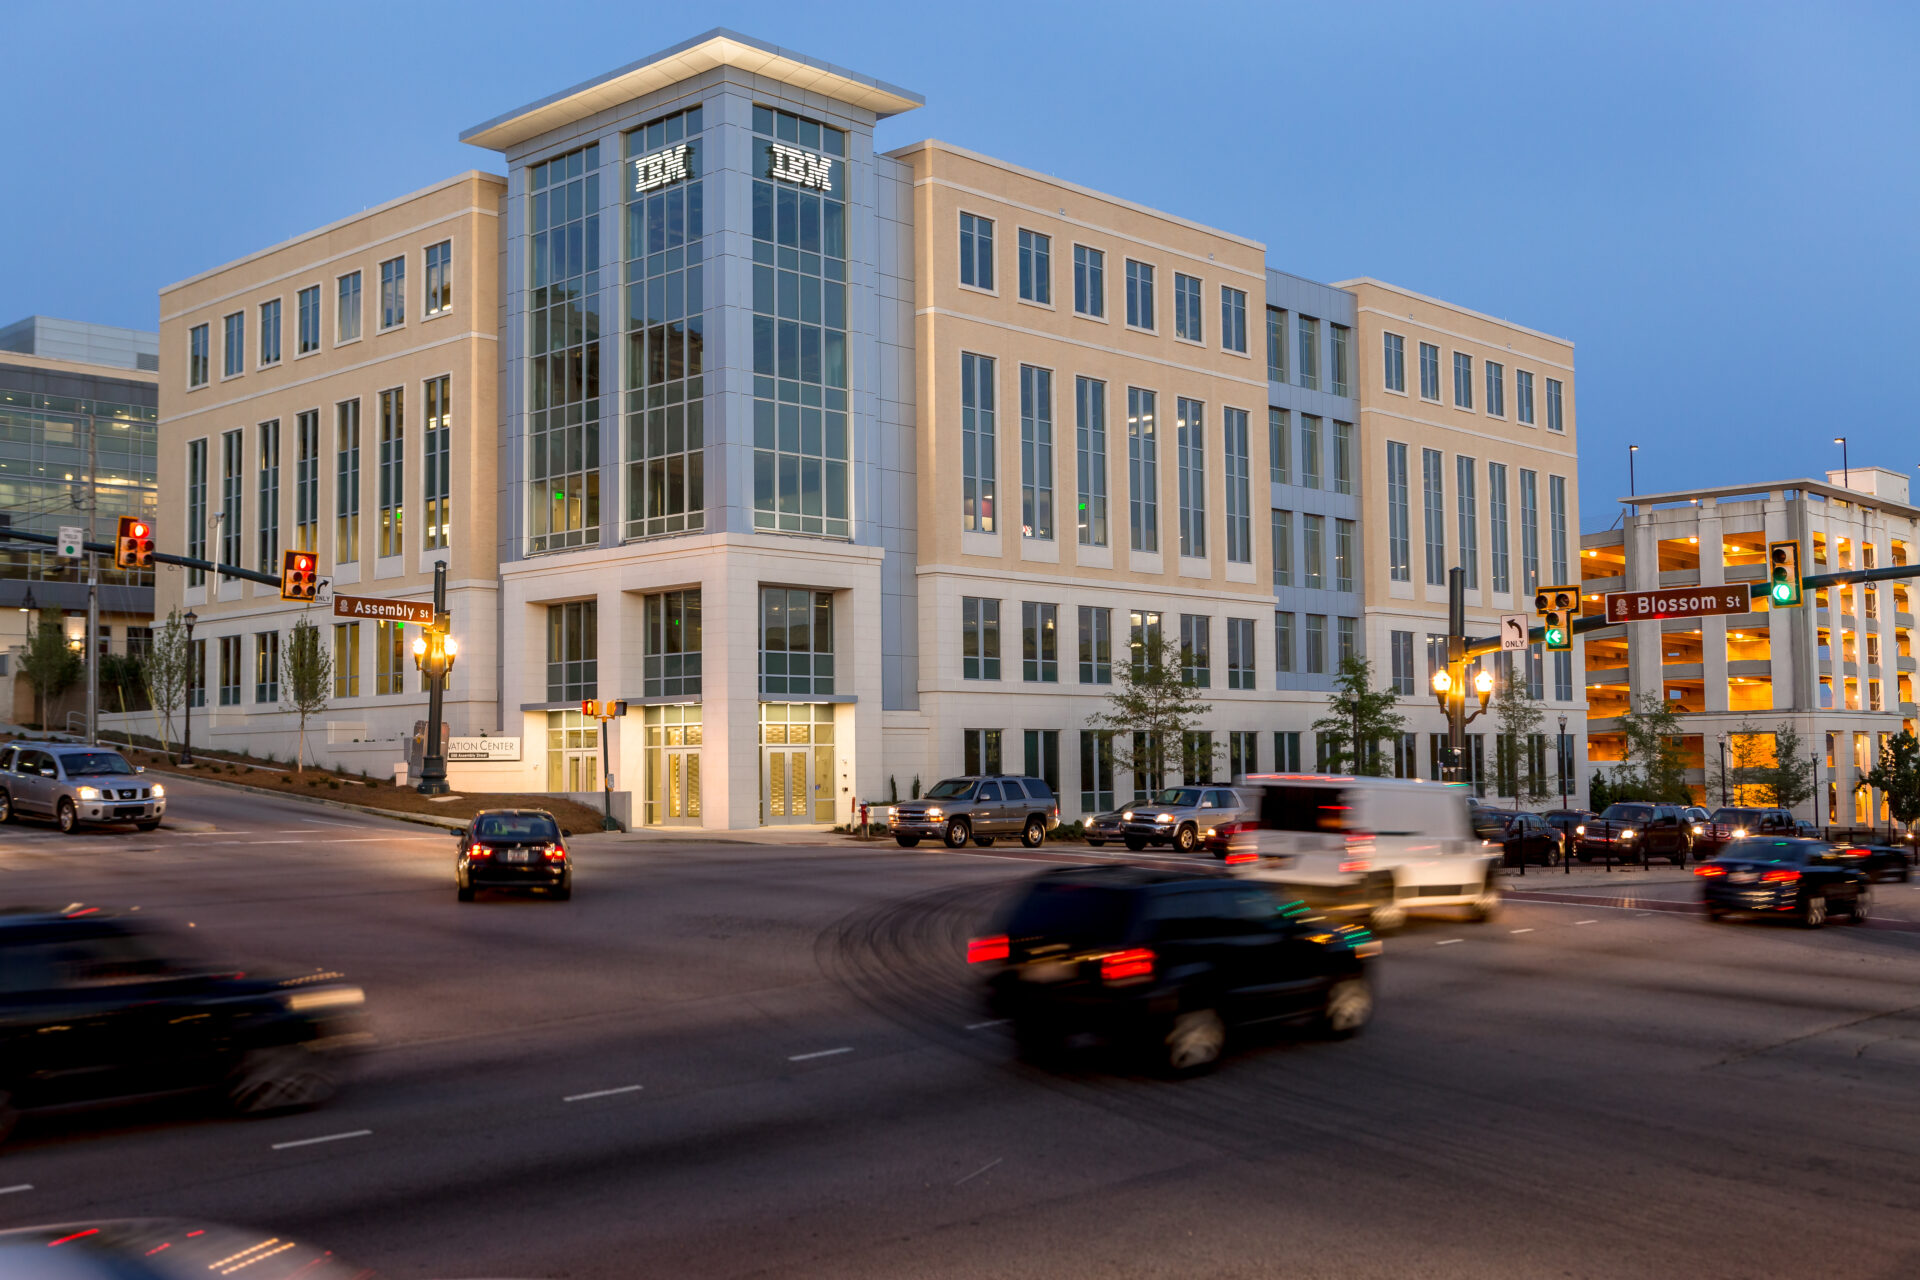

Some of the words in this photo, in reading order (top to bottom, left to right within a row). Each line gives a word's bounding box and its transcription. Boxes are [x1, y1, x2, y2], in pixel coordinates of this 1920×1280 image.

[636, 144, 686, 192] IBM
[773, 143, 832, 191] IBM
[354, 601, 414, 619] Assembly
[420, 610, 428, 618] St
[1638, 596, 1716, 613] Blossom
[1726, 596, 1740, 608] St
[1505, 640, 1524, 648] ONLY
